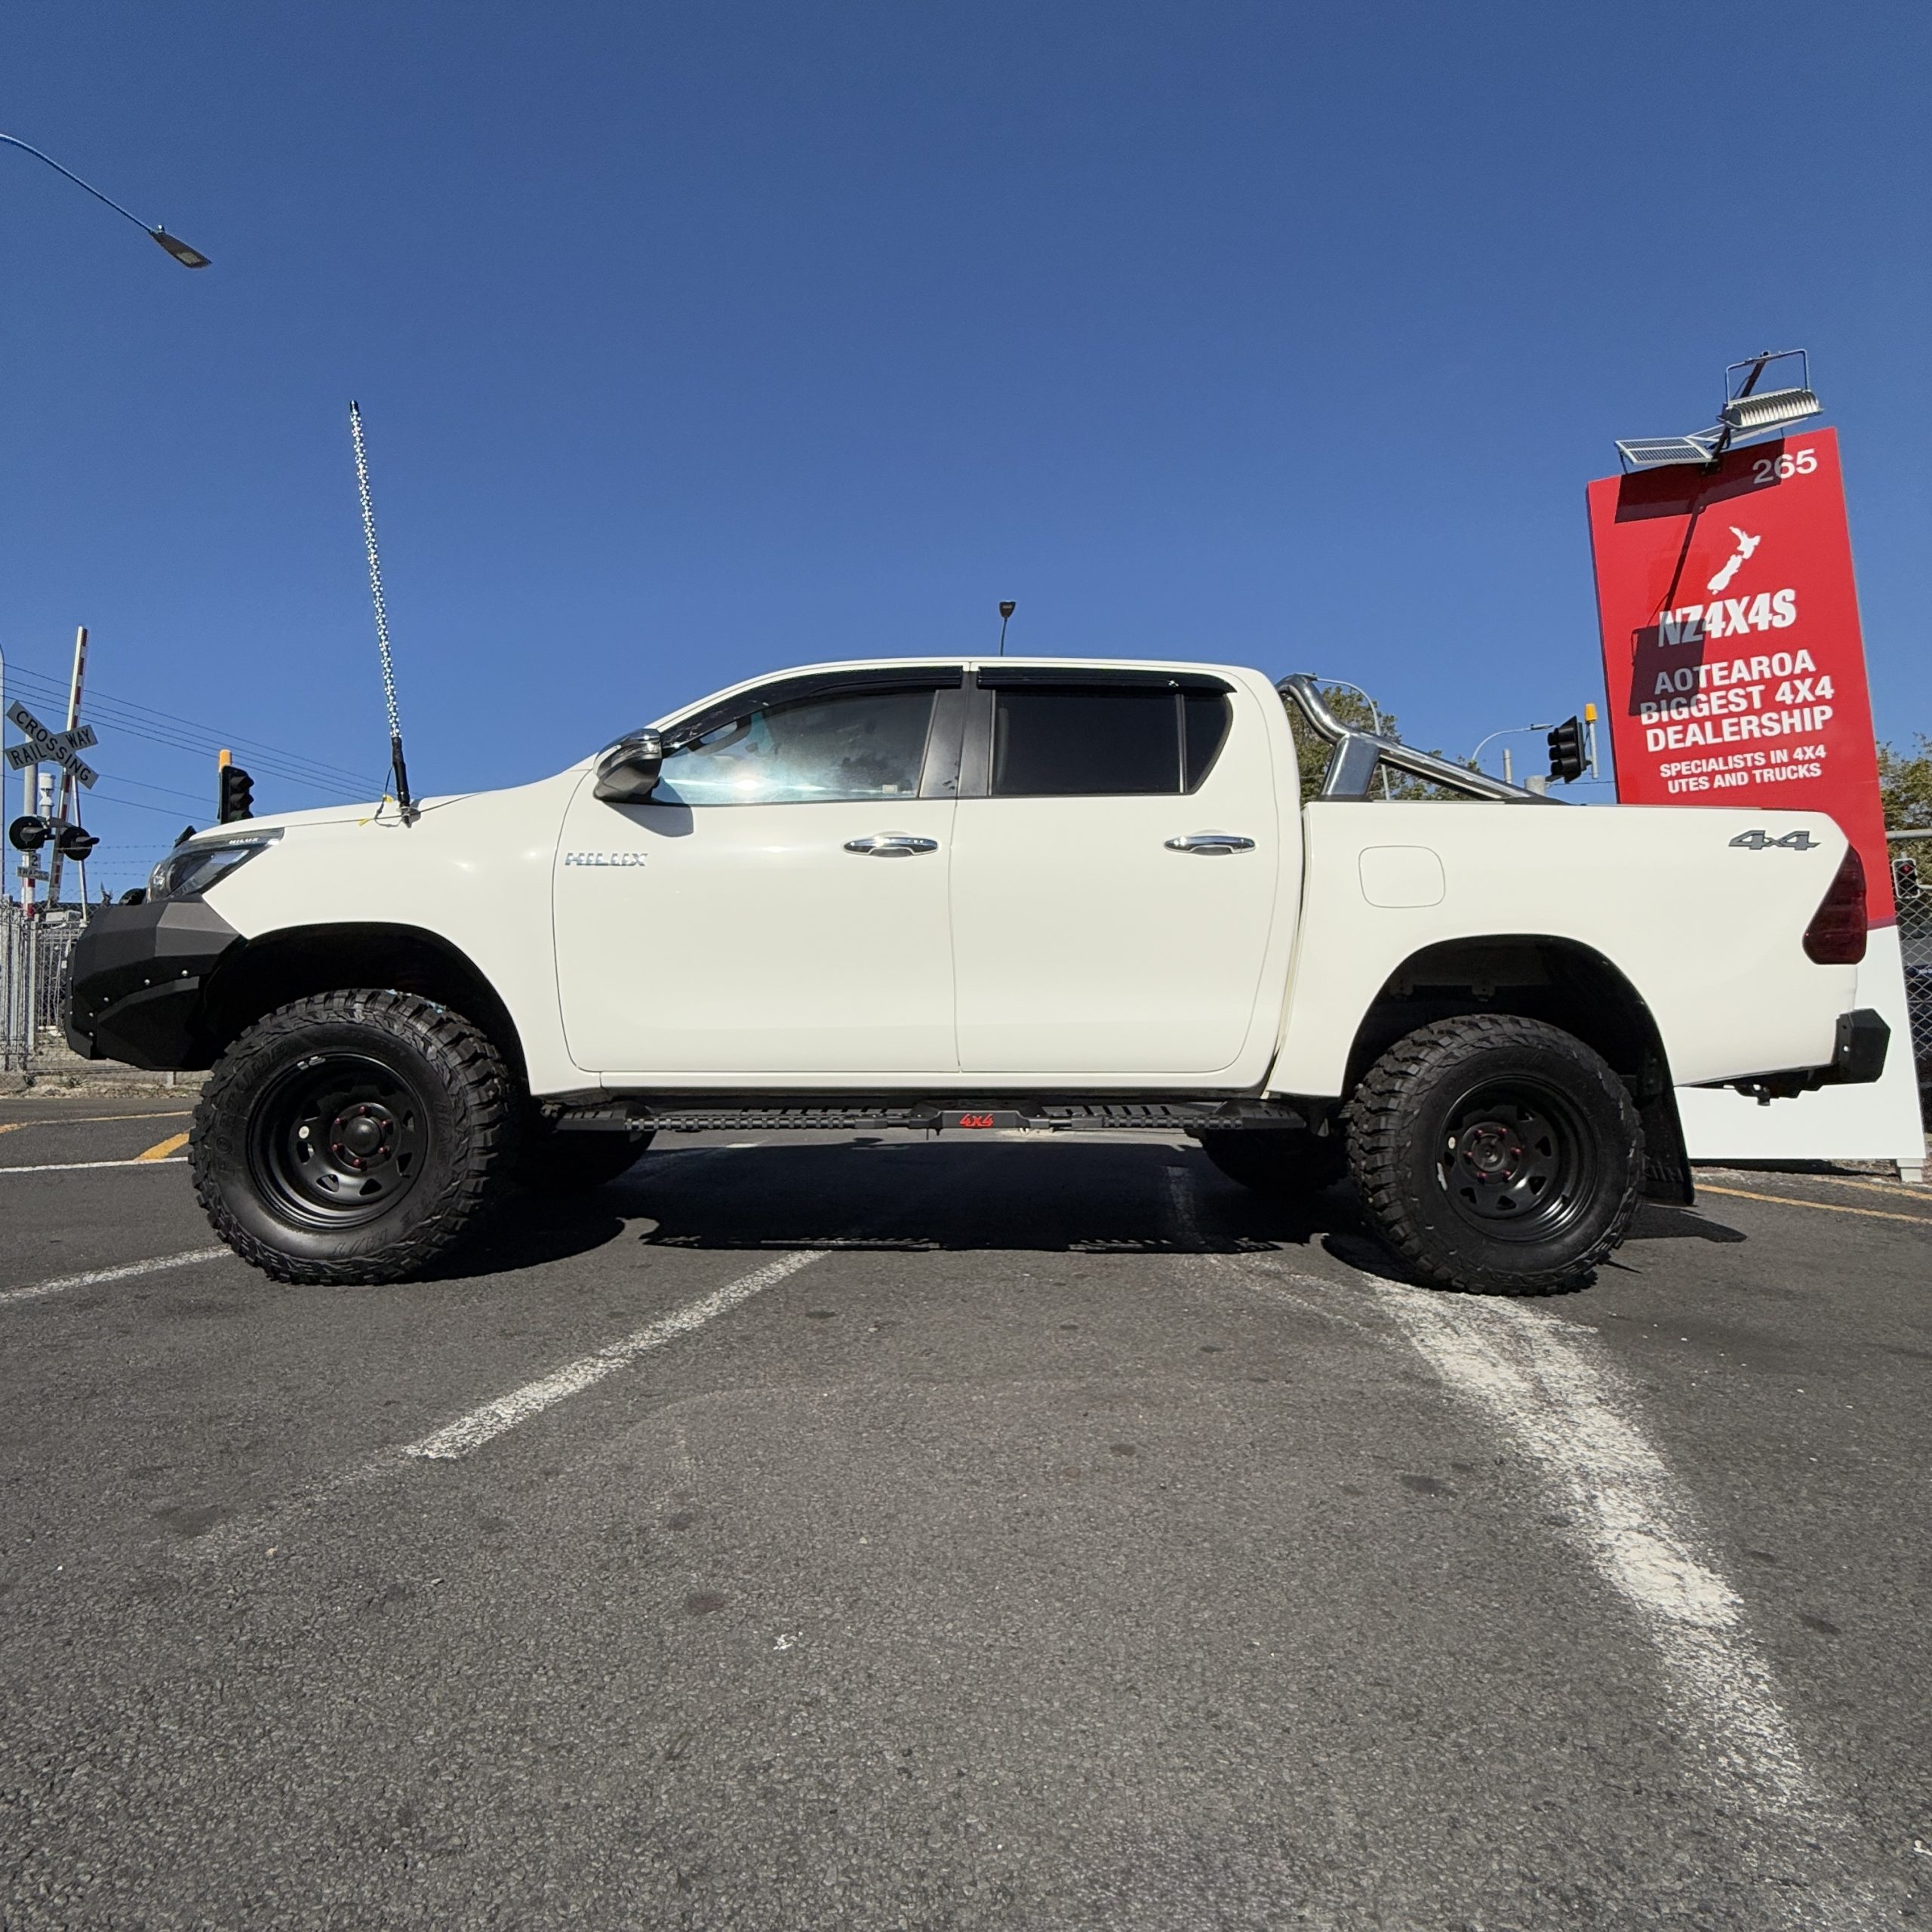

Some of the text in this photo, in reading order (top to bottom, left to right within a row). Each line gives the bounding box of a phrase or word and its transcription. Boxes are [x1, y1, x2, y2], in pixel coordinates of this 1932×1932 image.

[1752, 449, 1817, 484] 265
[1658, 589, 1796, 647] NZ4X4S
[1654, 649, 1817, 695] AOTEAROA
[1640, 675, 1834, 725] BIGGEST 4X4
[16, 711, 91, 781] CROSSING
[1646, 705, 1833, 752] DEALERSHIP
[1660, 744, 1826, 777] SPECIALISTS IN 4X4
[1668, 763, 1822, 794] UTES AND TRUCKS
[31, 855, 38, 866] 2
[565, 853, 648, 866] HILUX
